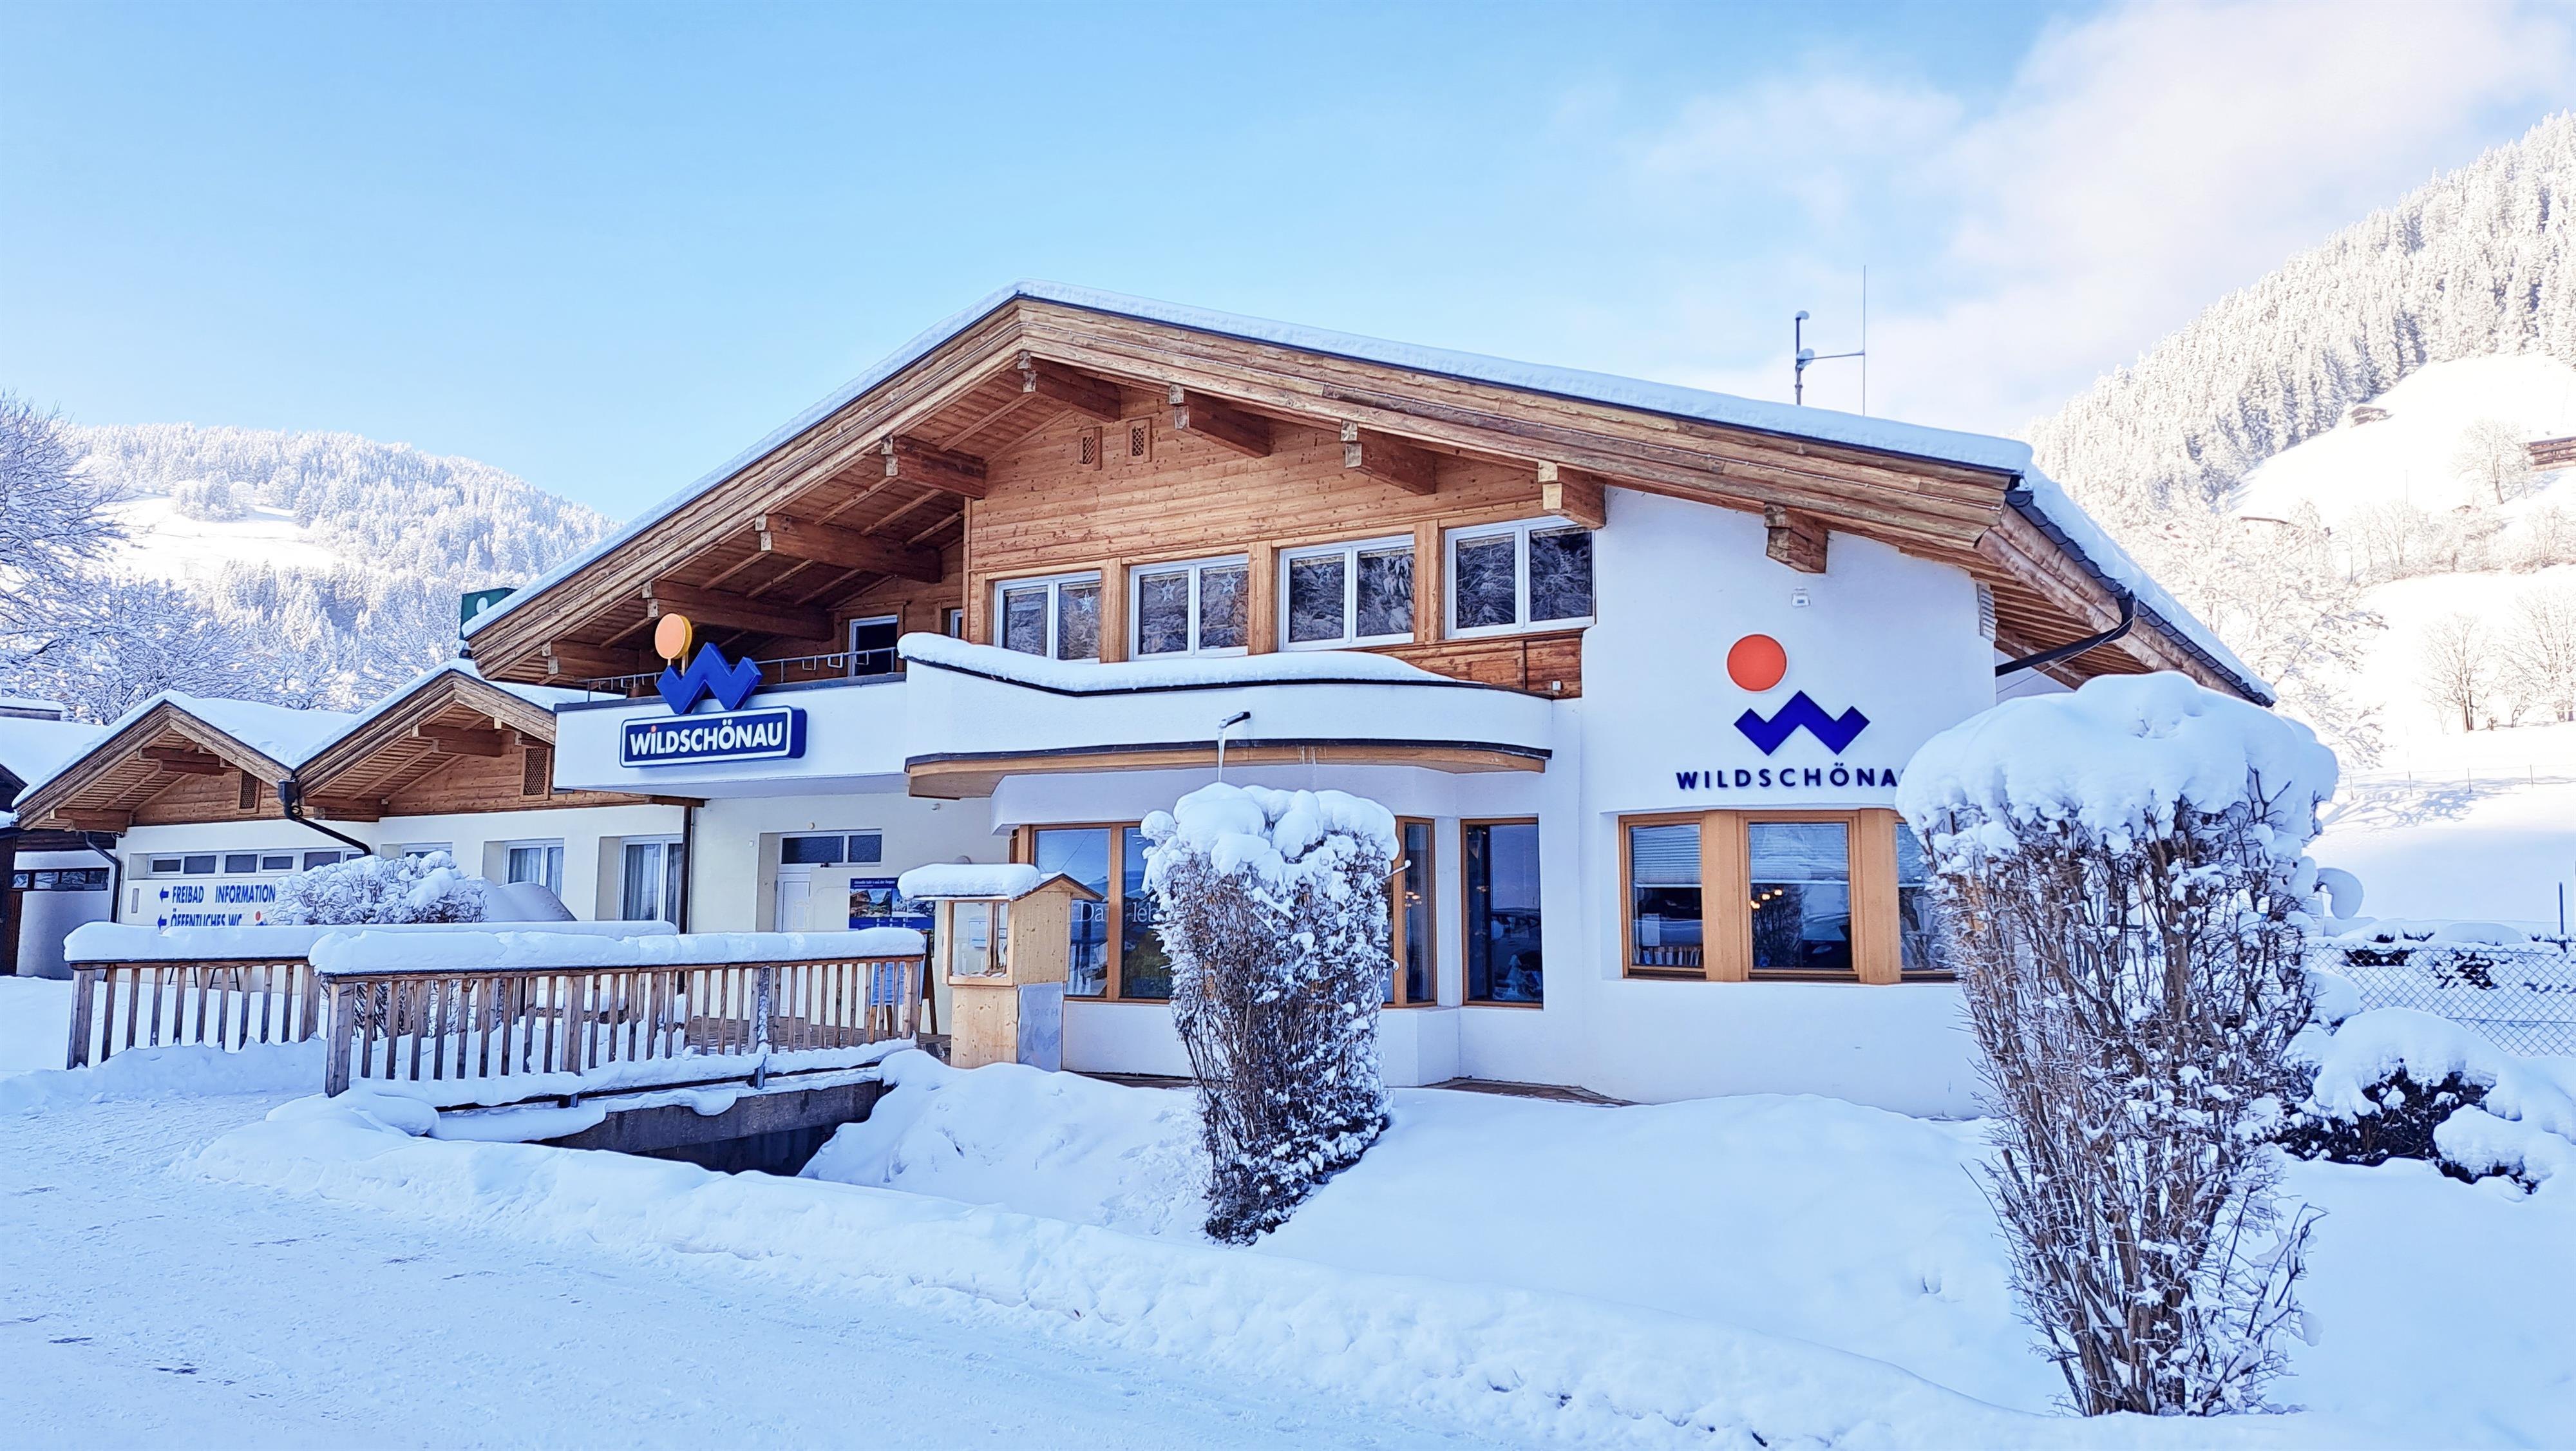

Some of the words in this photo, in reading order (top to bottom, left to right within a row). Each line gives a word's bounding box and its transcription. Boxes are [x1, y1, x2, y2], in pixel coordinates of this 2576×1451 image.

[1676, 762, 1904, 790] WILDSCHÖNA
[172, 886, 204, 903] FREIBAD
[215, 884, 275, 903] INFORMATION
[228, 914, 242, 926] WC
